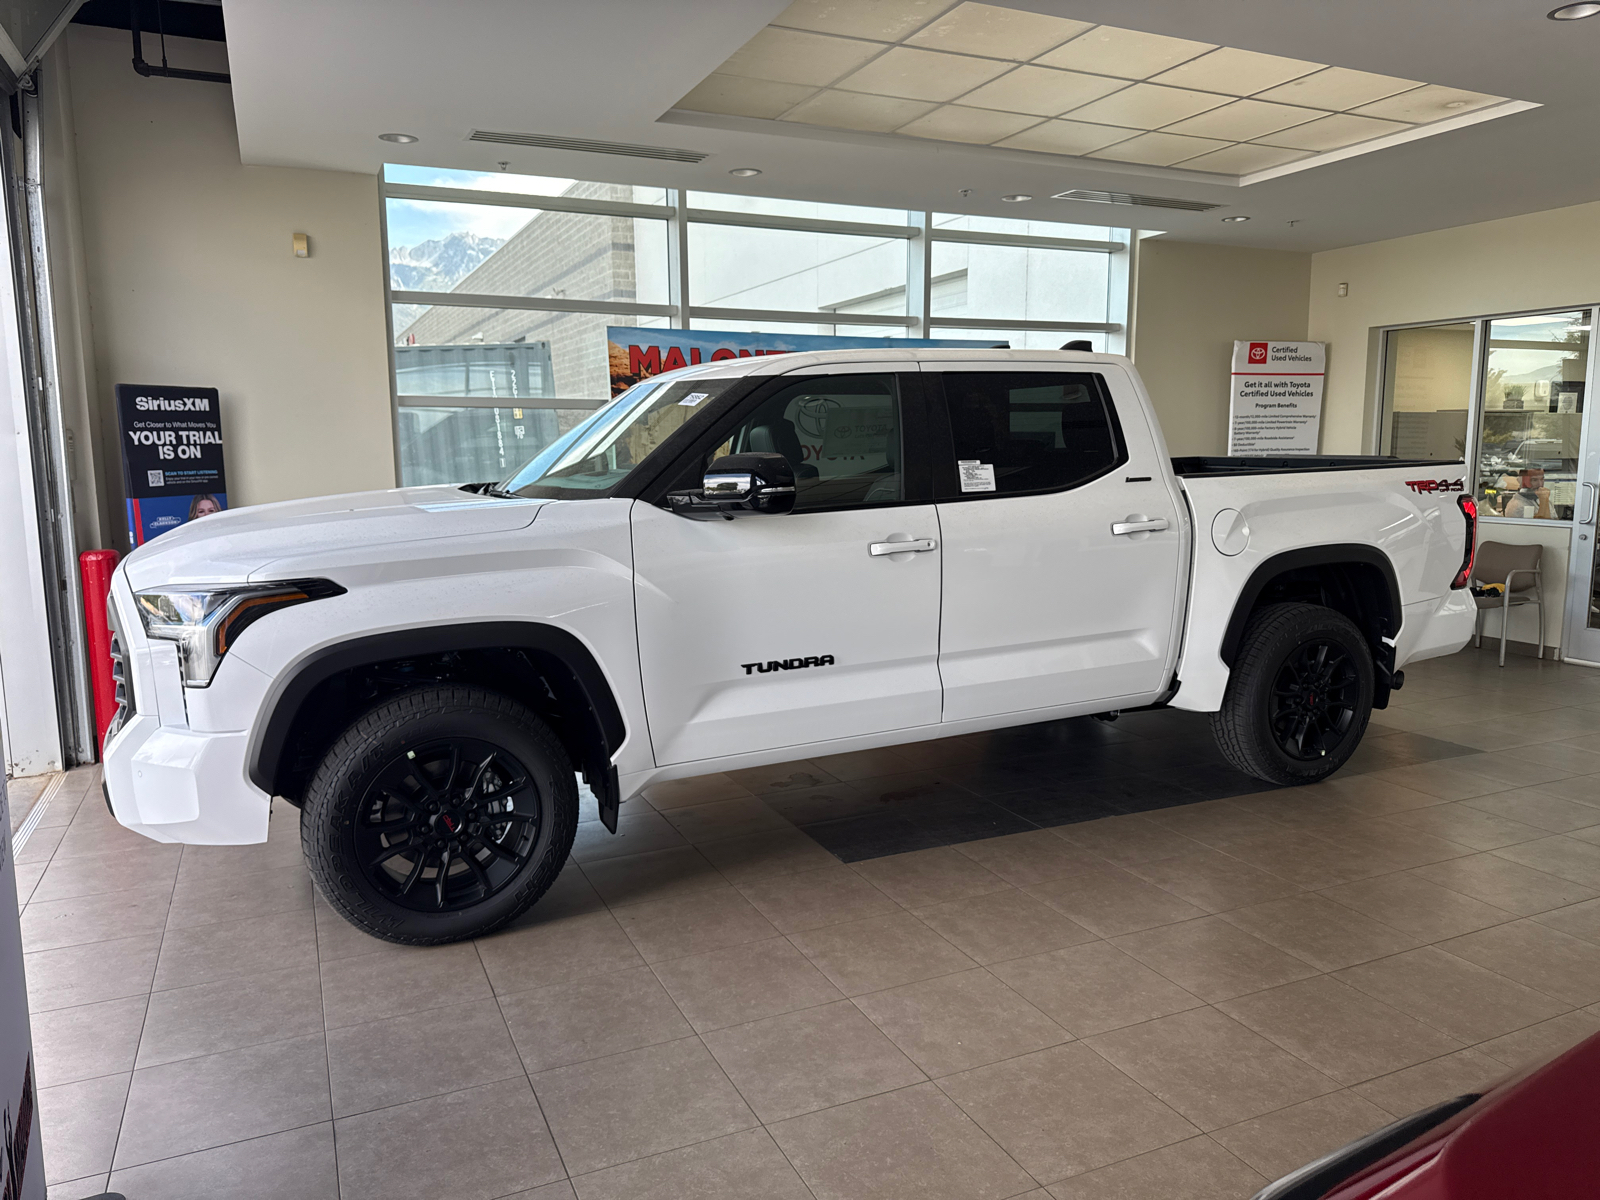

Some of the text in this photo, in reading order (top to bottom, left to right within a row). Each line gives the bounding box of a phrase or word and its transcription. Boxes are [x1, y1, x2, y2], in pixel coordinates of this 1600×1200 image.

[136, 396, 210, 411] SiriusXM
[129, 431, 223, 445] YOUR TRIAL
[158, 445, 201, 460] IS ON
[1405, 480, 1439, 494] TRD
[741, 654, 834, 675] TUNDRA
